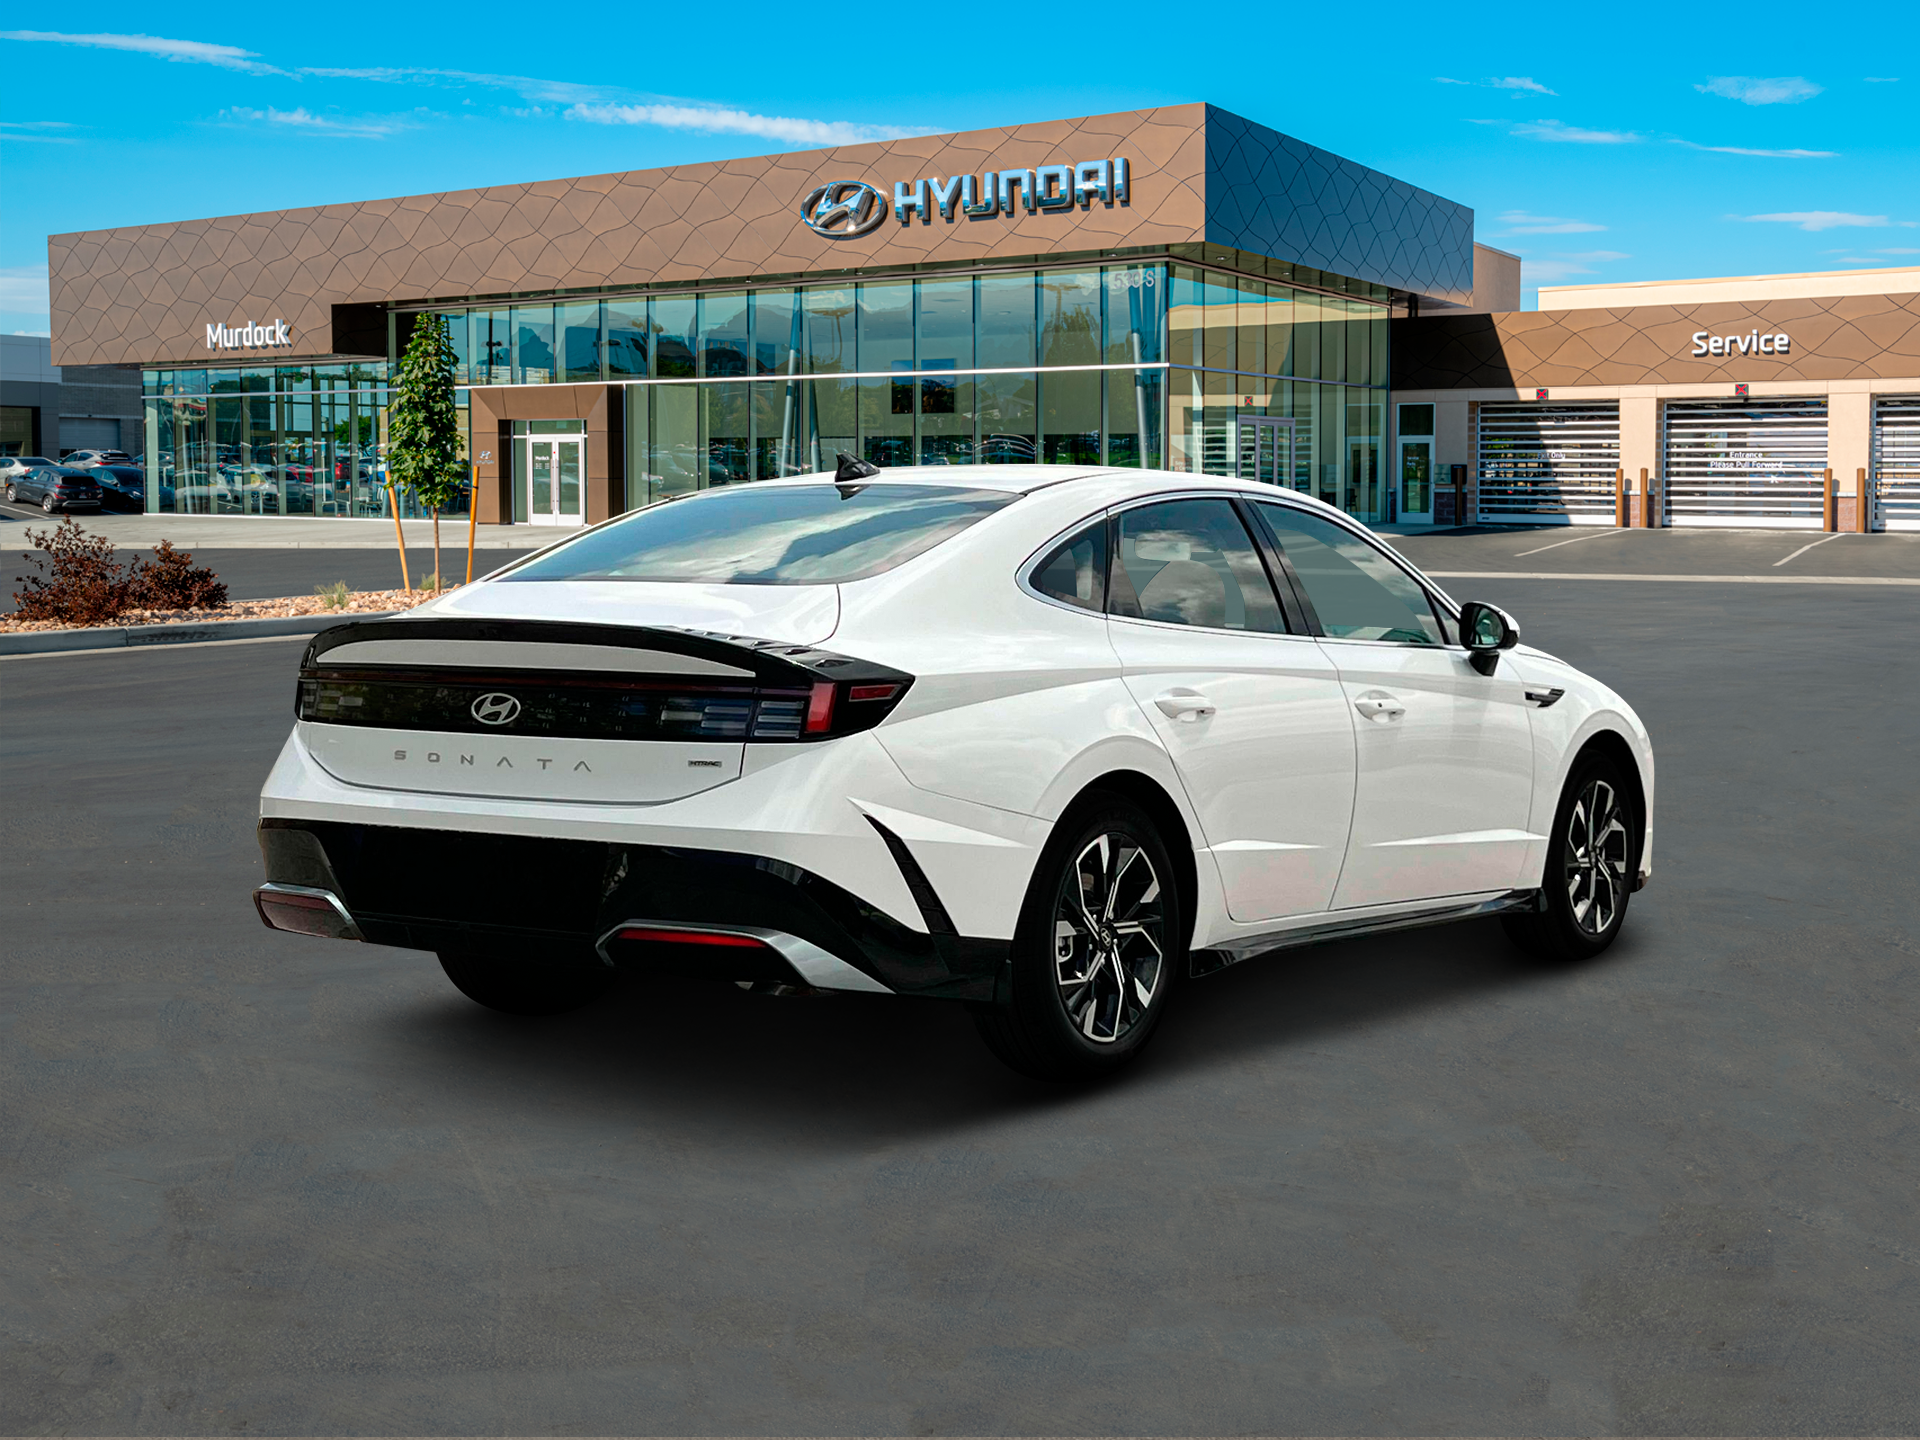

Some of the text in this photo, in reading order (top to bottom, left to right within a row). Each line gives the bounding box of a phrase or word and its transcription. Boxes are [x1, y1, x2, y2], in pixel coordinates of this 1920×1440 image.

[894, 157, 1130, 226] HYUNDAI
[1114, 270, 1155, 289] 530 S
[206, 319, 291, 350] Murdock
[1691, 329, 1790, 355] Service
[1551, 451, 1565, 460] Only
[1710, 460, 1783, 468] Please Pull Forward
[1729, 451, 1763, 459] Entrance
[394, 750, 592, 773] SONATA
